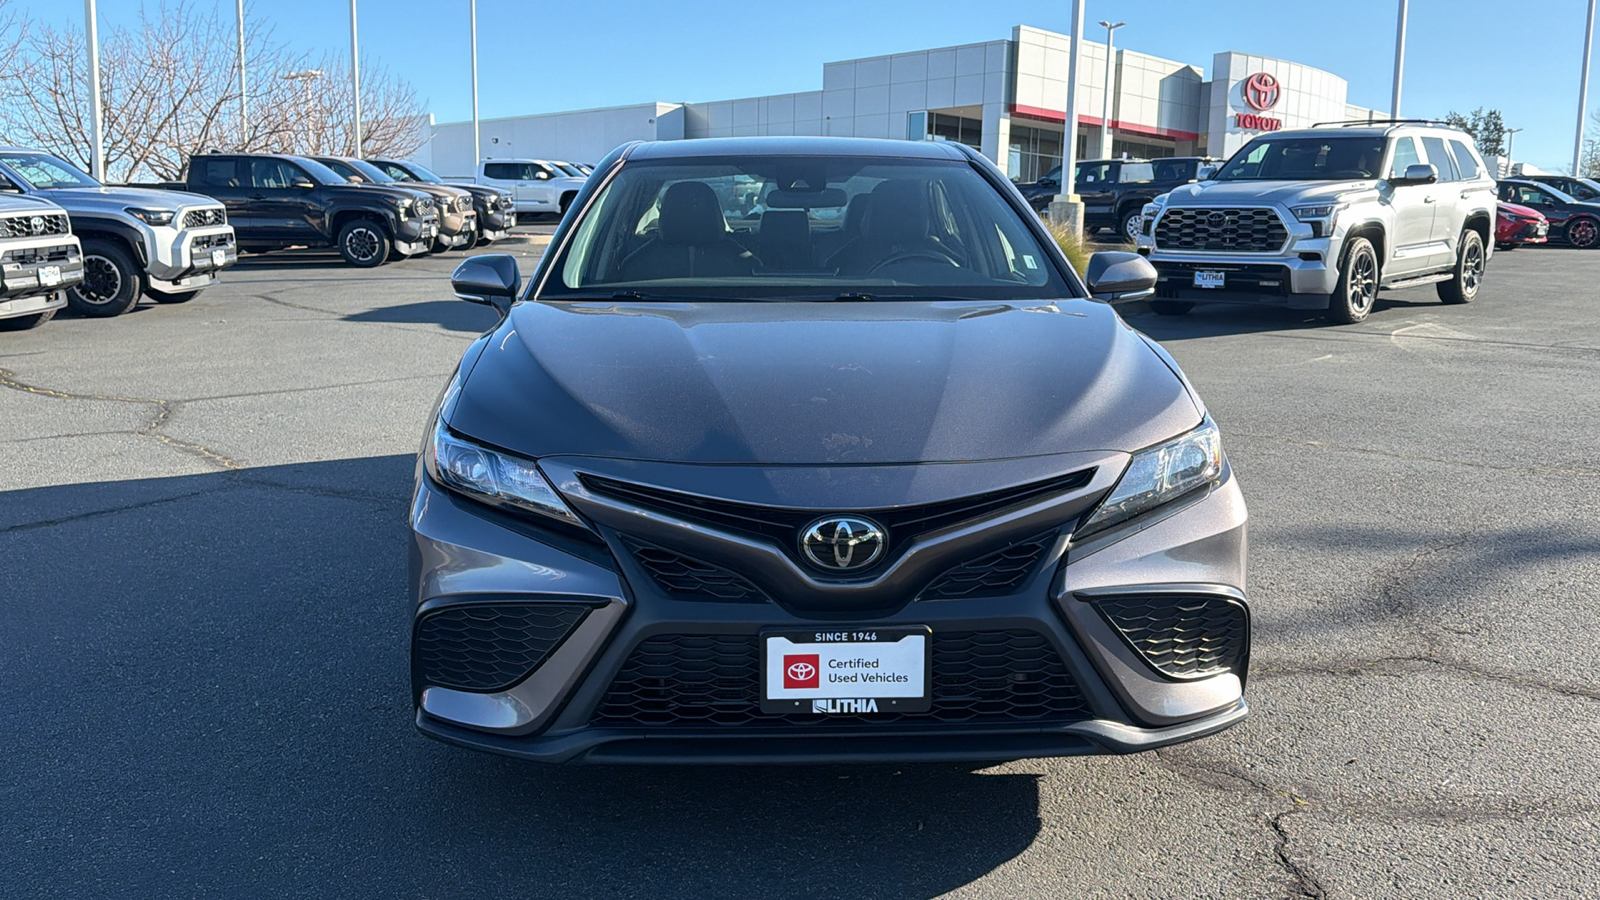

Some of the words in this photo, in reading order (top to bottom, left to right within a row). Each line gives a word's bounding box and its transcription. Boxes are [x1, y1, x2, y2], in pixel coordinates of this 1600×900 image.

[1236, 113, 1282, 131] TOYOTA
[815, 632, 848, 641] SINCE
[852, 632, 877, 641] 1946
[828, 658, 879, 669] Certified
[828, 673, 858, 683] Used
[861, 672, 909, 683] Vehicles
[827, 699, 879, 713] LITHIA
